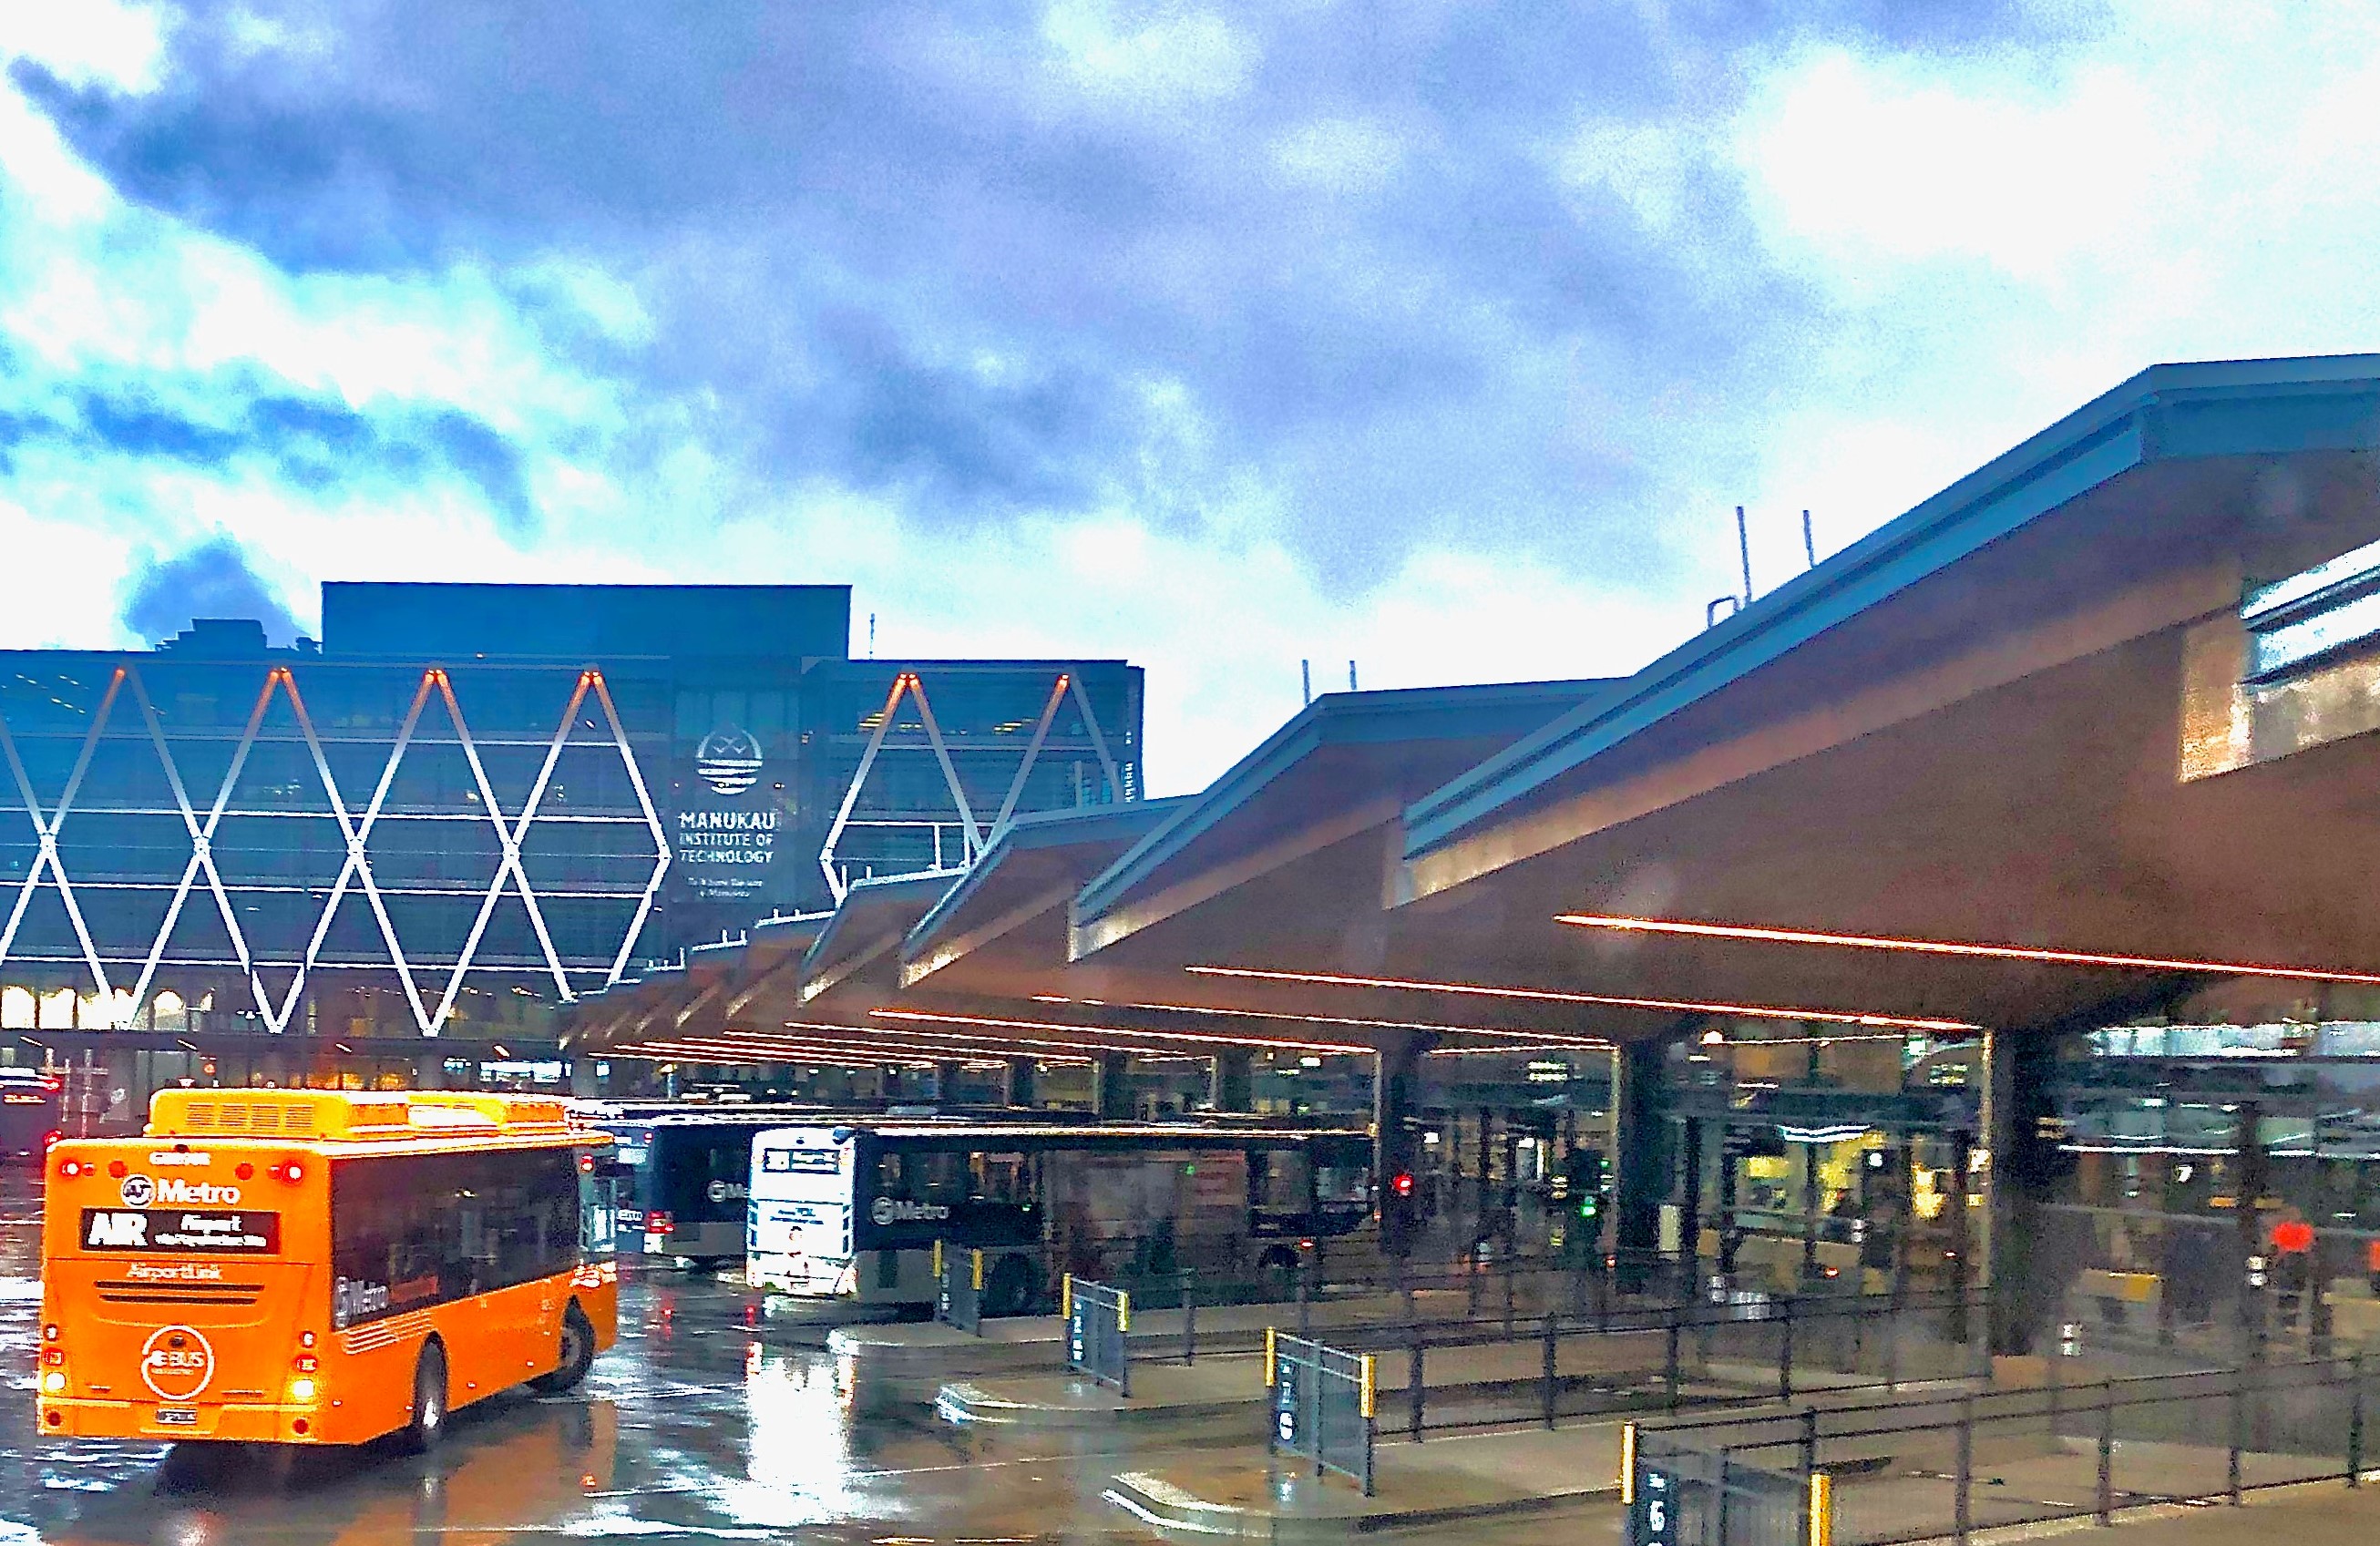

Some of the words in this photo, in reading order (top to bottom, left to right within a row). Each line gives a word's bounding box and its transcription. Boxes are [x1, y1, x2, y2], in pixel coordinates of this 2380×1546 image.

[679, 812, 775, 830] MANUKAU
[679, 833, 751, 845] INSTITUTE
[755, 833, 774, 845] OF
[679, 849, 774, 864] TECHNOLOGY
[157, 1178, 241, 1204] Metro
[88, 1212, 149, 1246] AIR
